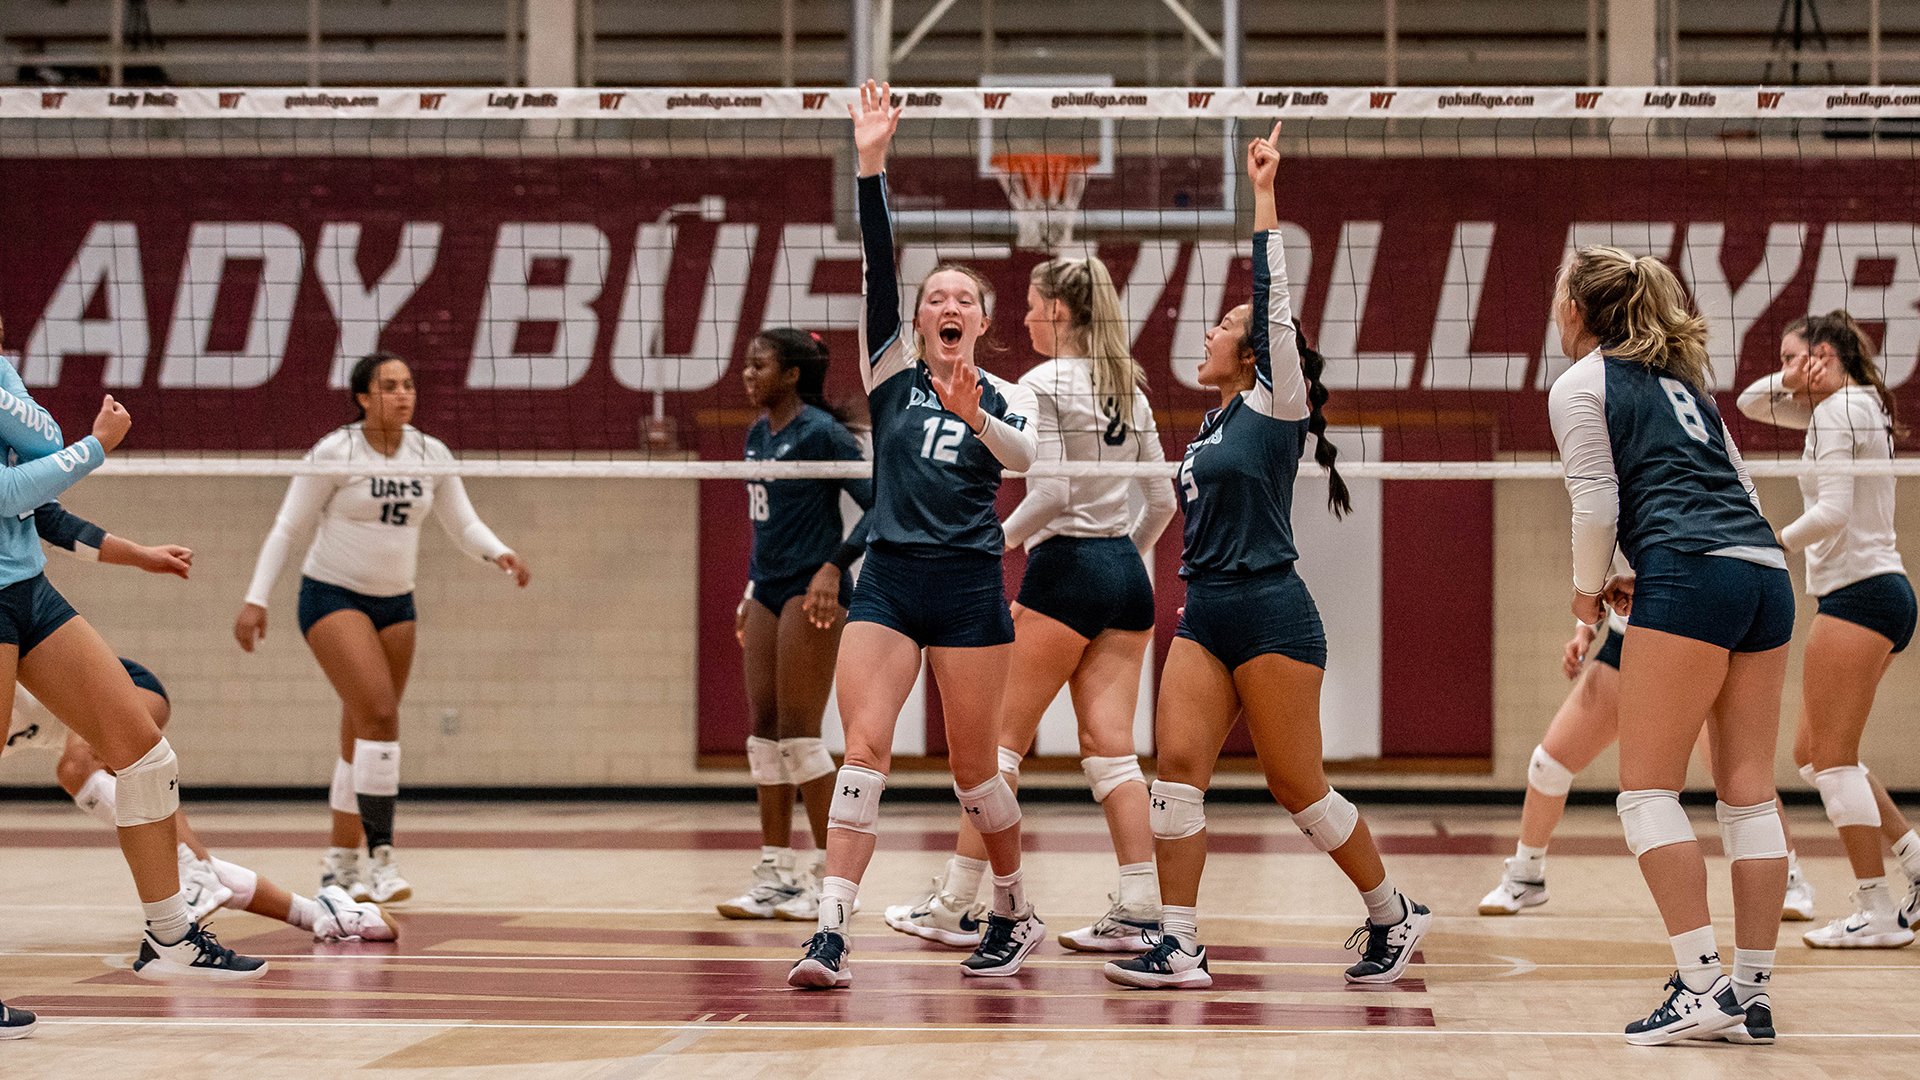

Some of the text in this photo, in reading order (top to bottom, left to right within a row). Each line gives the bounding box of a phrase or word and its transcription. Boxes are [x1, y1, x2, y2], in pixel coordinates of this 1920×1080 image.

[487, 93, 558, 109] Lady Buffs
[666, 93, 762, 110] gobuffsgo.com
[802, 93, 829, 110] WT
[905, 93, 943, 107] Buffs
[983, 92, 1011, 110] WT
[1051, 92, 1147, 109] gobuffsgo.com
[1187, 91, 1215, 109] WT
[1256, 91, 1328, 108] Lady Buffs
[1369, 91, 1397, 109] WT
[1438, 92, 1535, 109] gobuffsgo.com
[1575, 91, 1603, 109] WT
[1644, 91, 1717, 108] Lady Buffs
[1757, 91, 1785, 109] WT
[0, 221, 444, 389] ADY
[1658, 376, 1711, 444] 8
[920, 416, 966, 465] 12
[51, 441, 90, 473] GO
[747, 483, 770, 522] 18
[380, 501, 412, 526] 15
